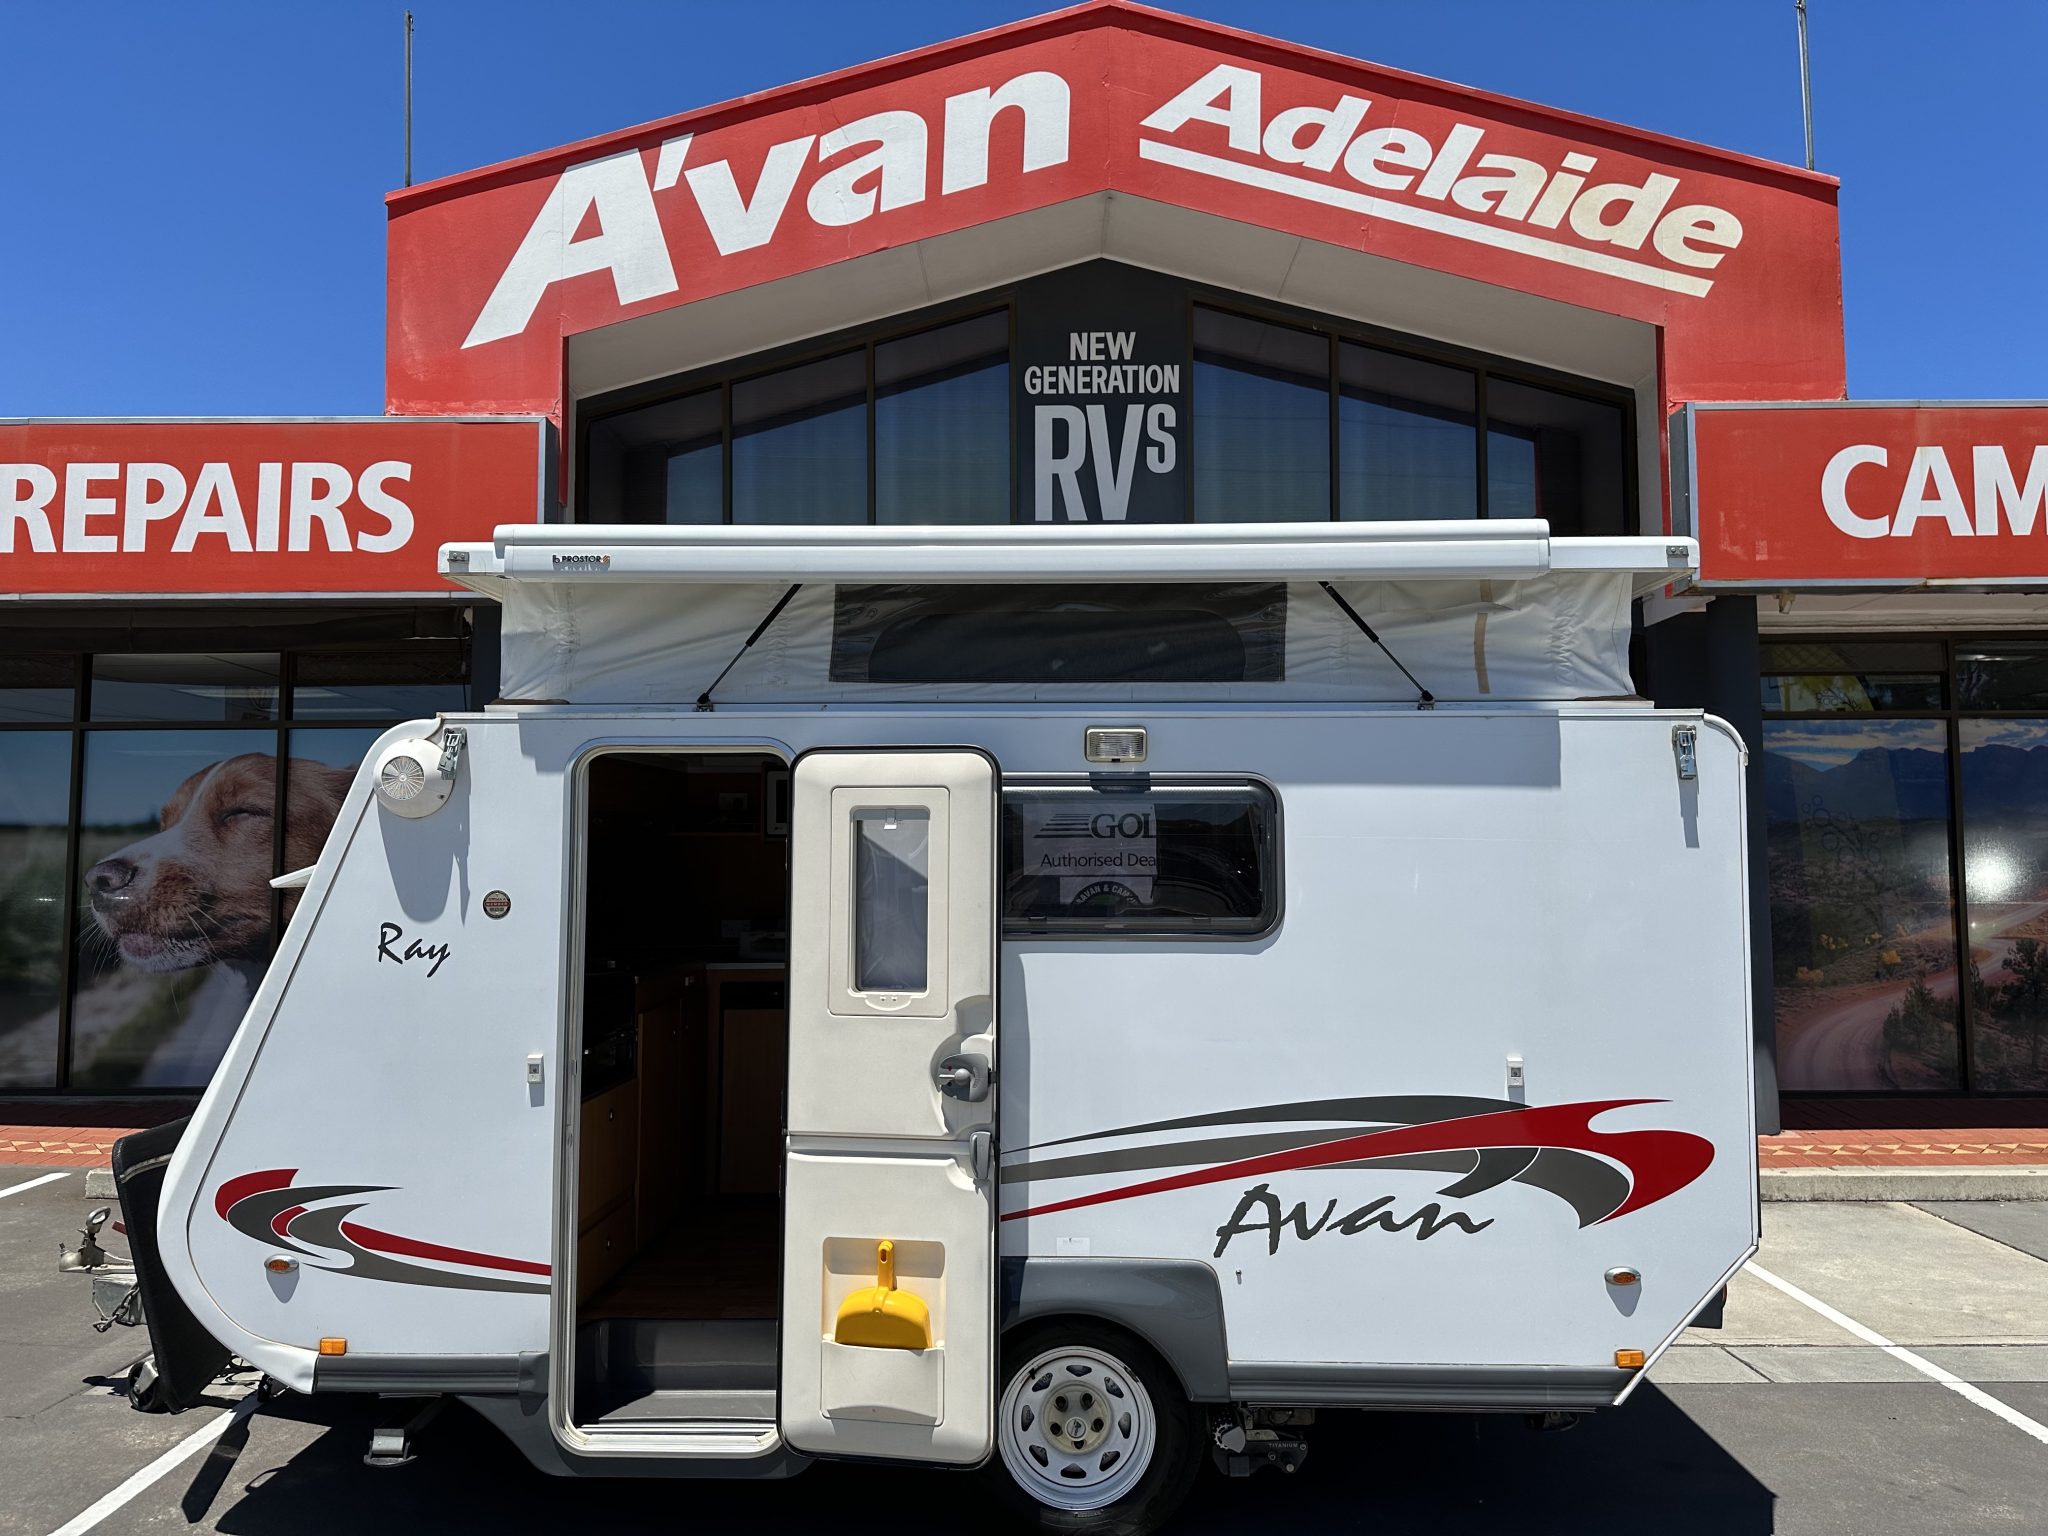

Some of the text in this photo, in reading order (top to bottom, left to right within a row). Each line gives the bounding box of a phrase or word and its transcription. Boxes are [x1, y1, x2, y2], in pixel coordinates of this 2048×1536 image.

[462, 63, 1744, 346] A'van Adelaide
[1069, 331, 1136, 361] NEW
[1024, 364, 1180, 395] GENERATION
[0, 460, 415, 554] REPAIRS
[1821, 444, 2048, 539] CAM
[1040, 851, 1156, 868] Authorised Dea
[377, 921, 451, 978] Ray
[1213, 1183, 1495, 1258] Avan
